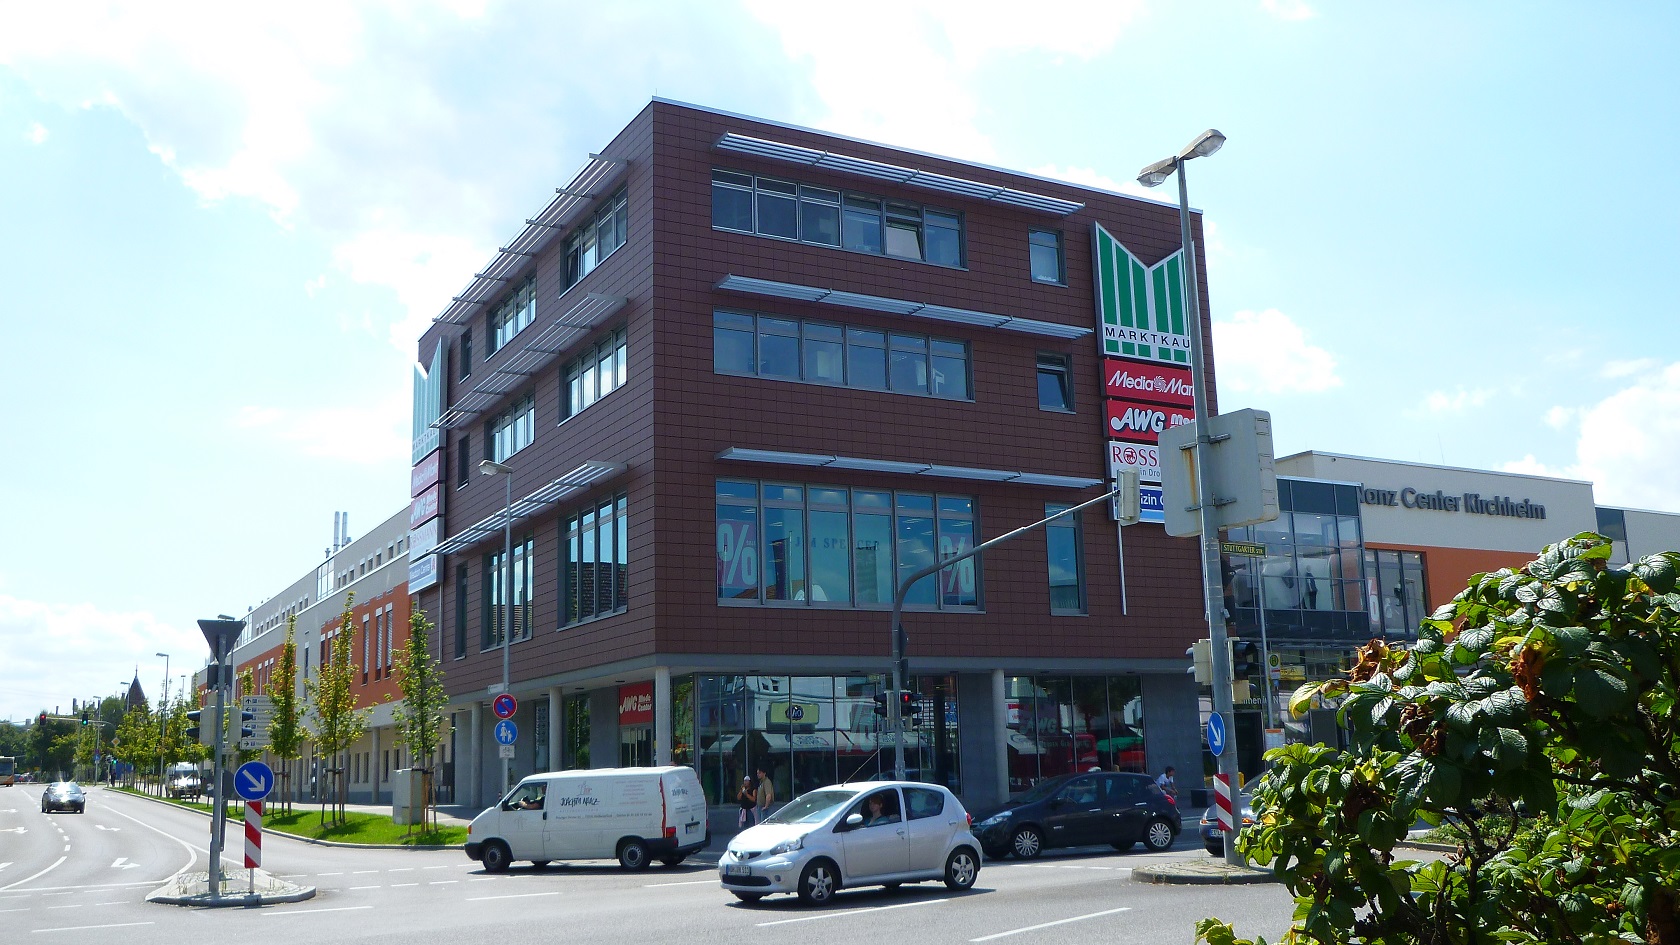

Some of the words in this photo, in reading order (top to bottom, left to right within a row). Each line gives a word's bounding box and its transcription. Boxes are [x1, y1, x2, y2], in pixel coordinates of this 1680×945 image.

[1105, 327, 1190, 348] MARKTKAU
[1108, 370, 1154, 391] Media
[1164, 377, 1194, 397] Mar
[1111, 407, 1165, 433] AWG
[1112, 446, 1160, 467] ROSS
[1140, 493, 1157, 506] izin
[1401, 487, 1461, 512] Center
[1464, 492, 1546, 520] Kirchheim
